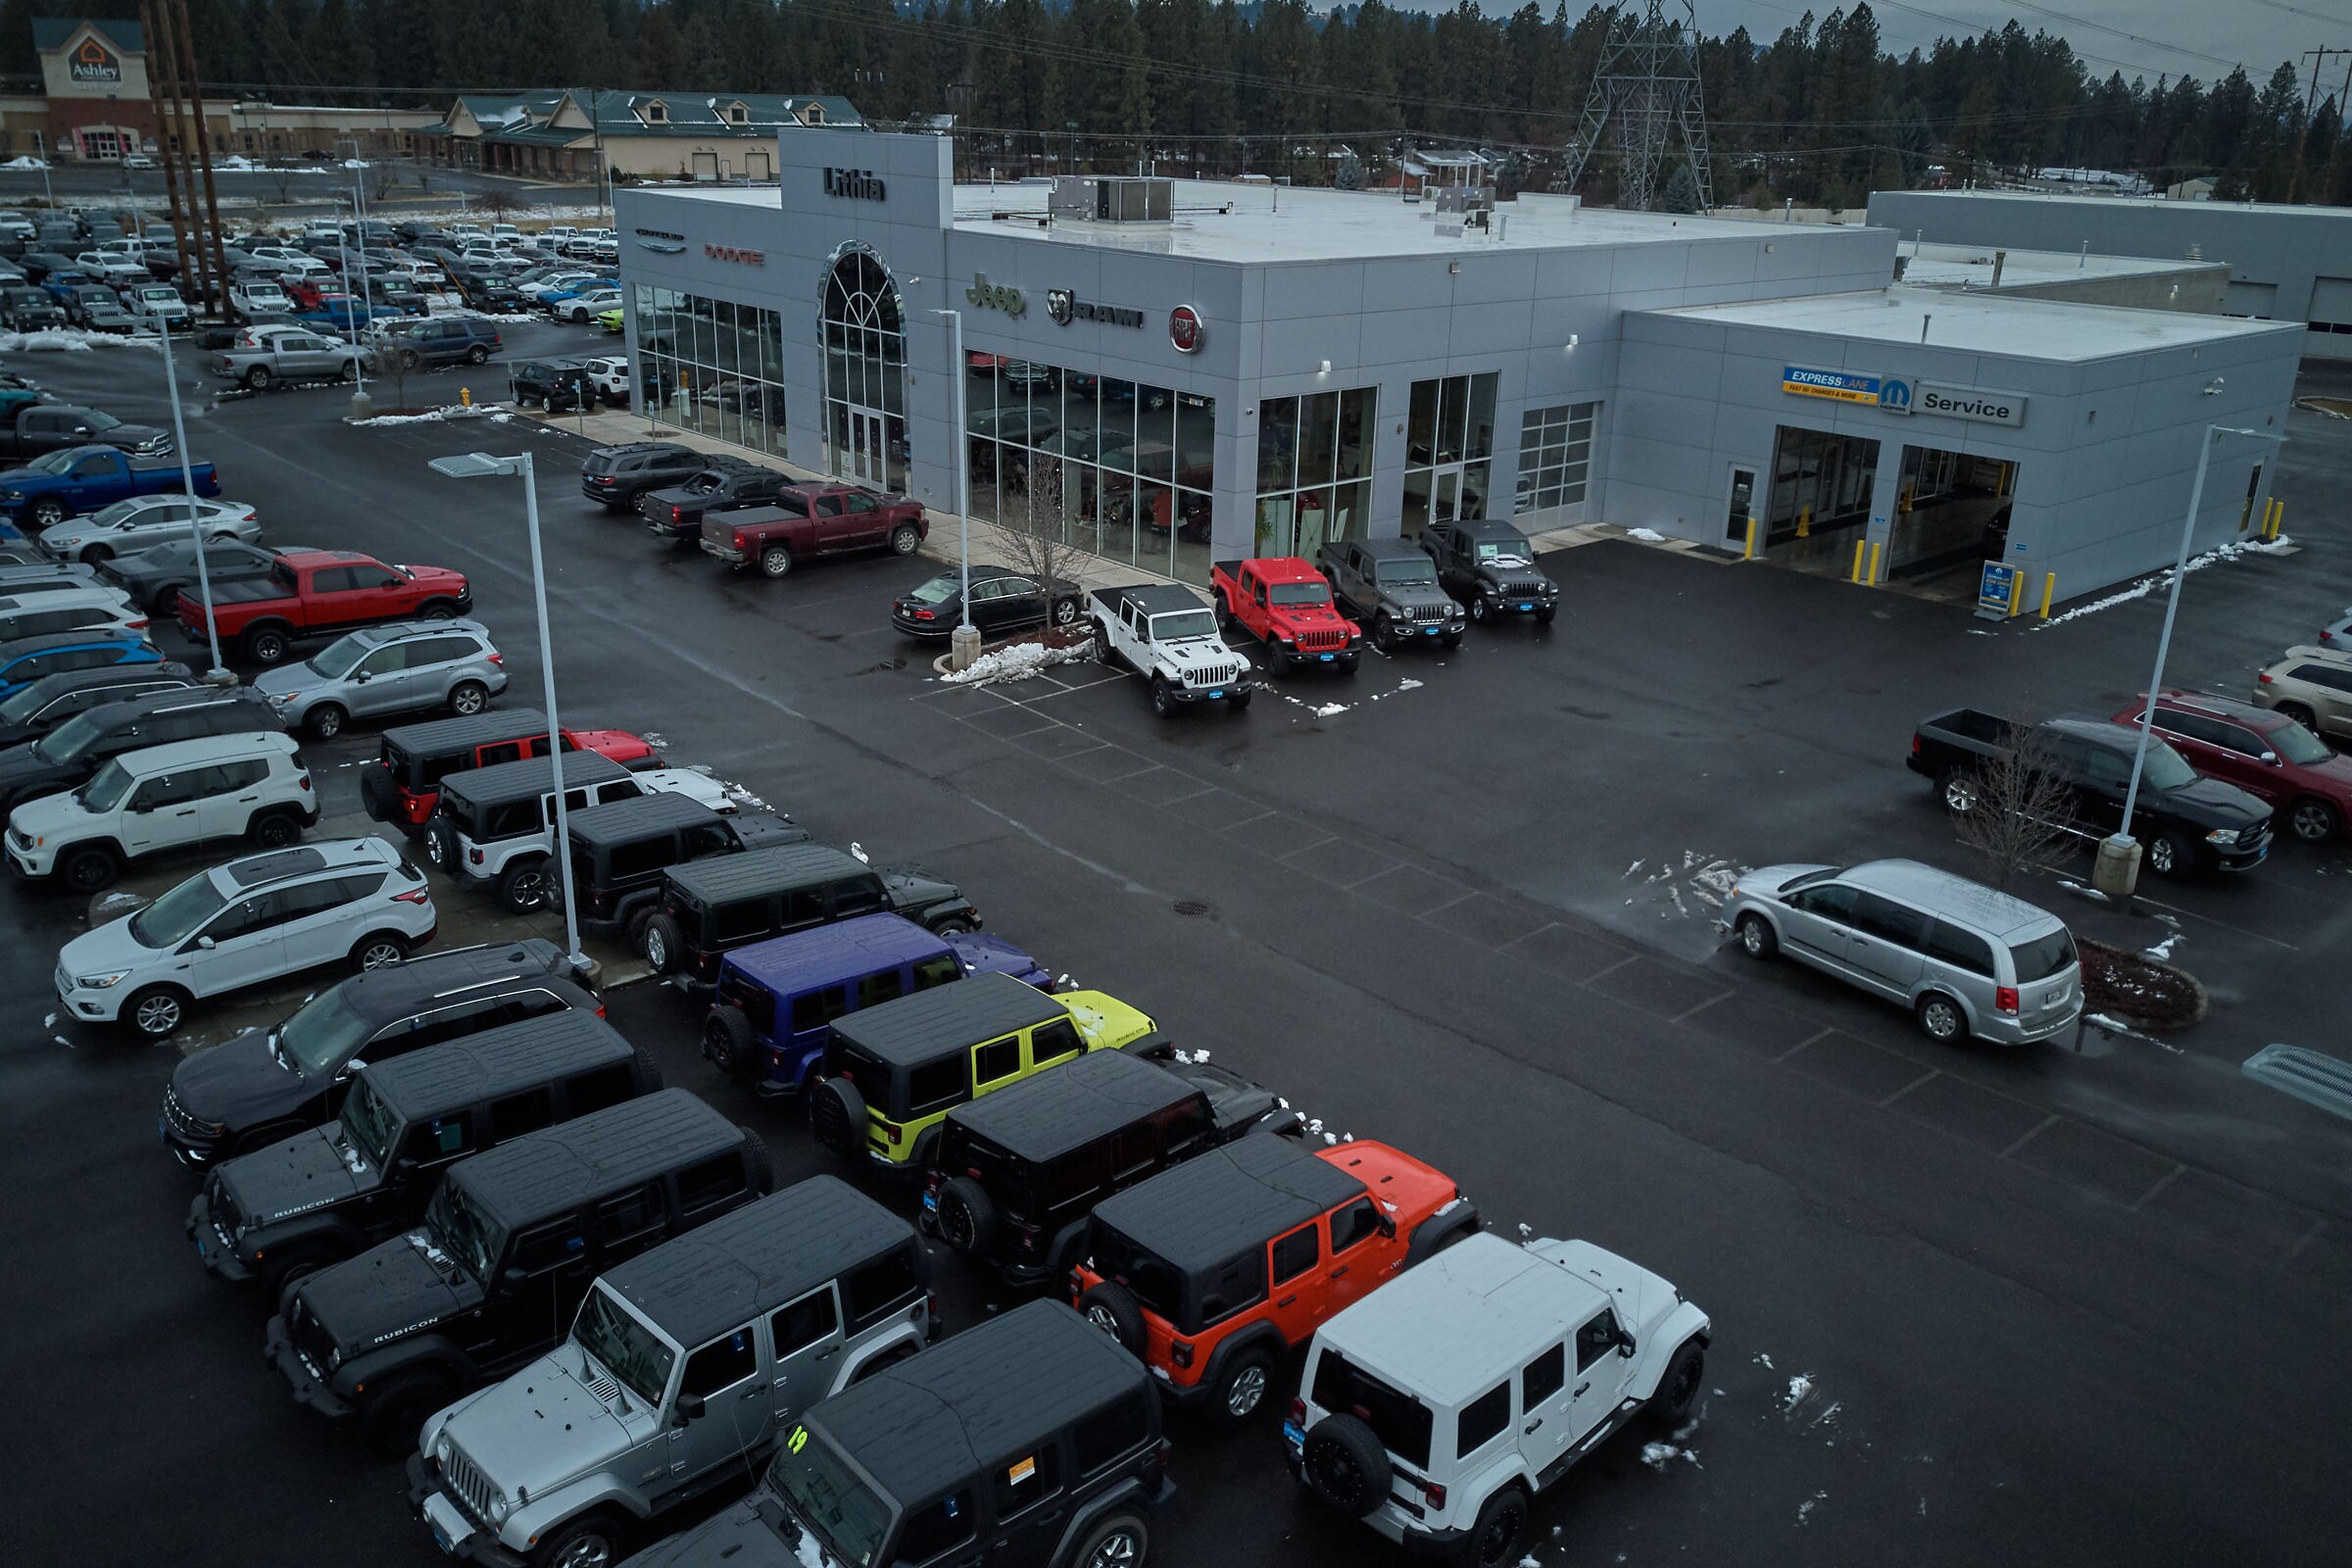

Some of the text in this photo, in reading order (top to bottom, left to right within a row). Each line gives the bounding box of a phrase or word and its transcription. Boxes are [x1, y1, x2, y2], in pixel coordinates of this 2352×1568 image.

[73, 63, 118, 79] Ashley
[822, 168, 886, 202] Lithia
[705, 243, 764, 267] DODGE
[965, 272, 1027, 320] Jeep
[1074, 303, 1144, 328] RAM
[1925, 393, 2009, 418] Service
[274, 1198, 334, 1218] RUBICON
[373, 1316, 439, 1344] RUBICON
[787, 1425, 808, 1455] 19
